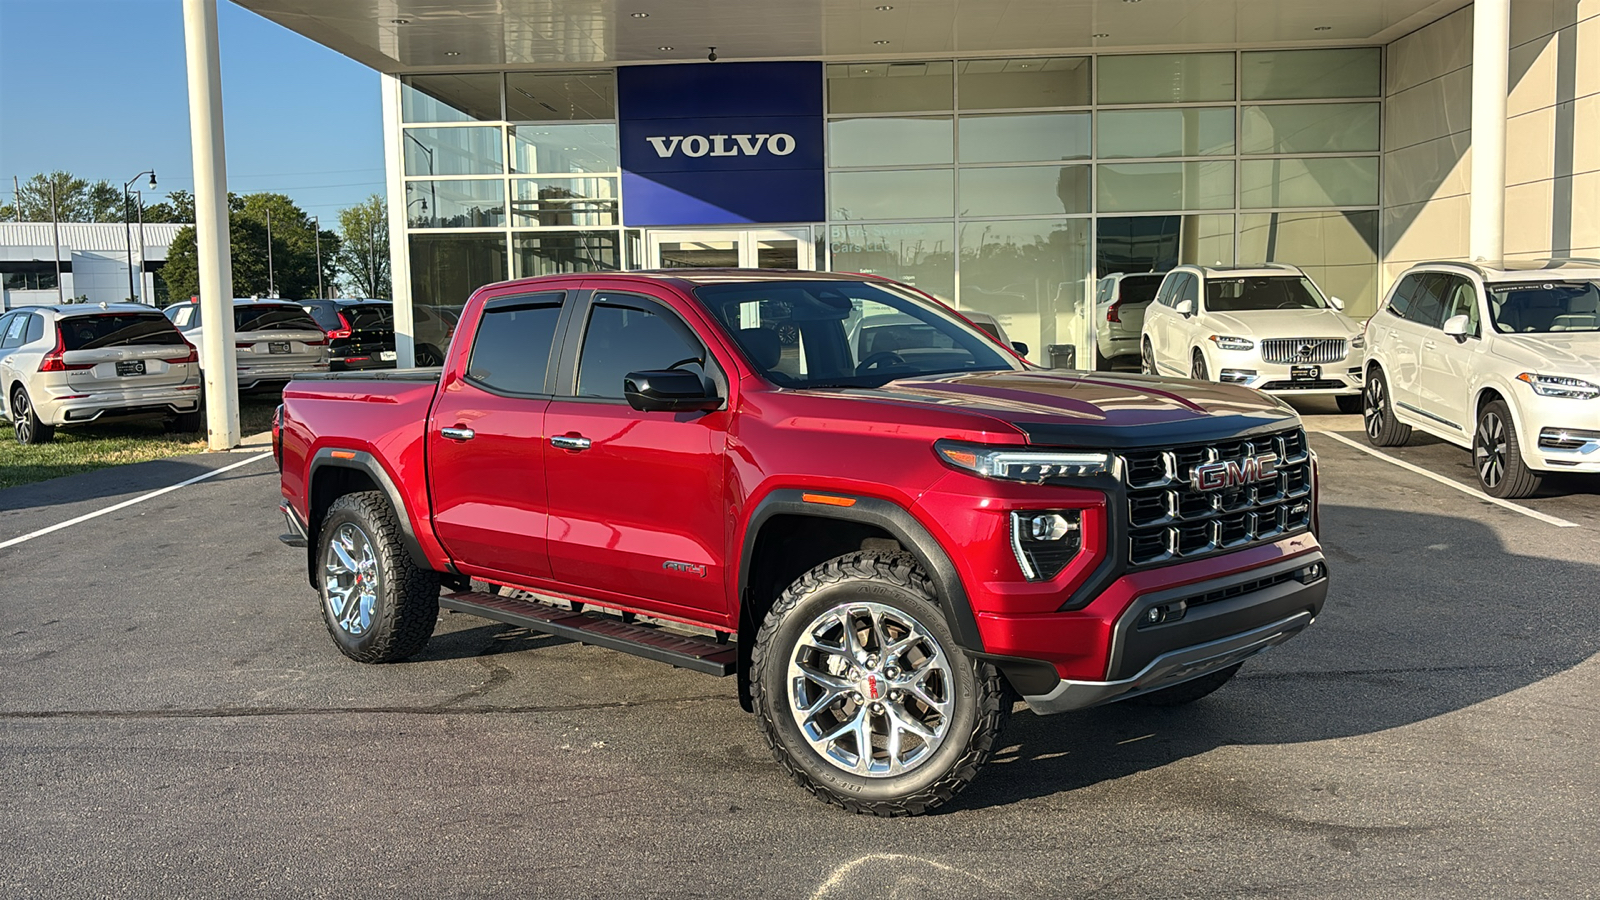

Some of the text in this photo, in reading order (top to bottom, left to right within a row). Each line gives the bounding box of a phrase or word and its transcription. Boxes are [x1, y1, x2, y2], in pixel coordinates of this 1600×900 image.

[646, 134, 796, 158] VOLVO
[831, 227, 868, 240] Byers
[831, 241, 891, 254] Cars LLC
[1194, 453, 1278, 491] GMC
[662, 560, 707, 578] AT4
[867, 674, 879, 700] GMC
